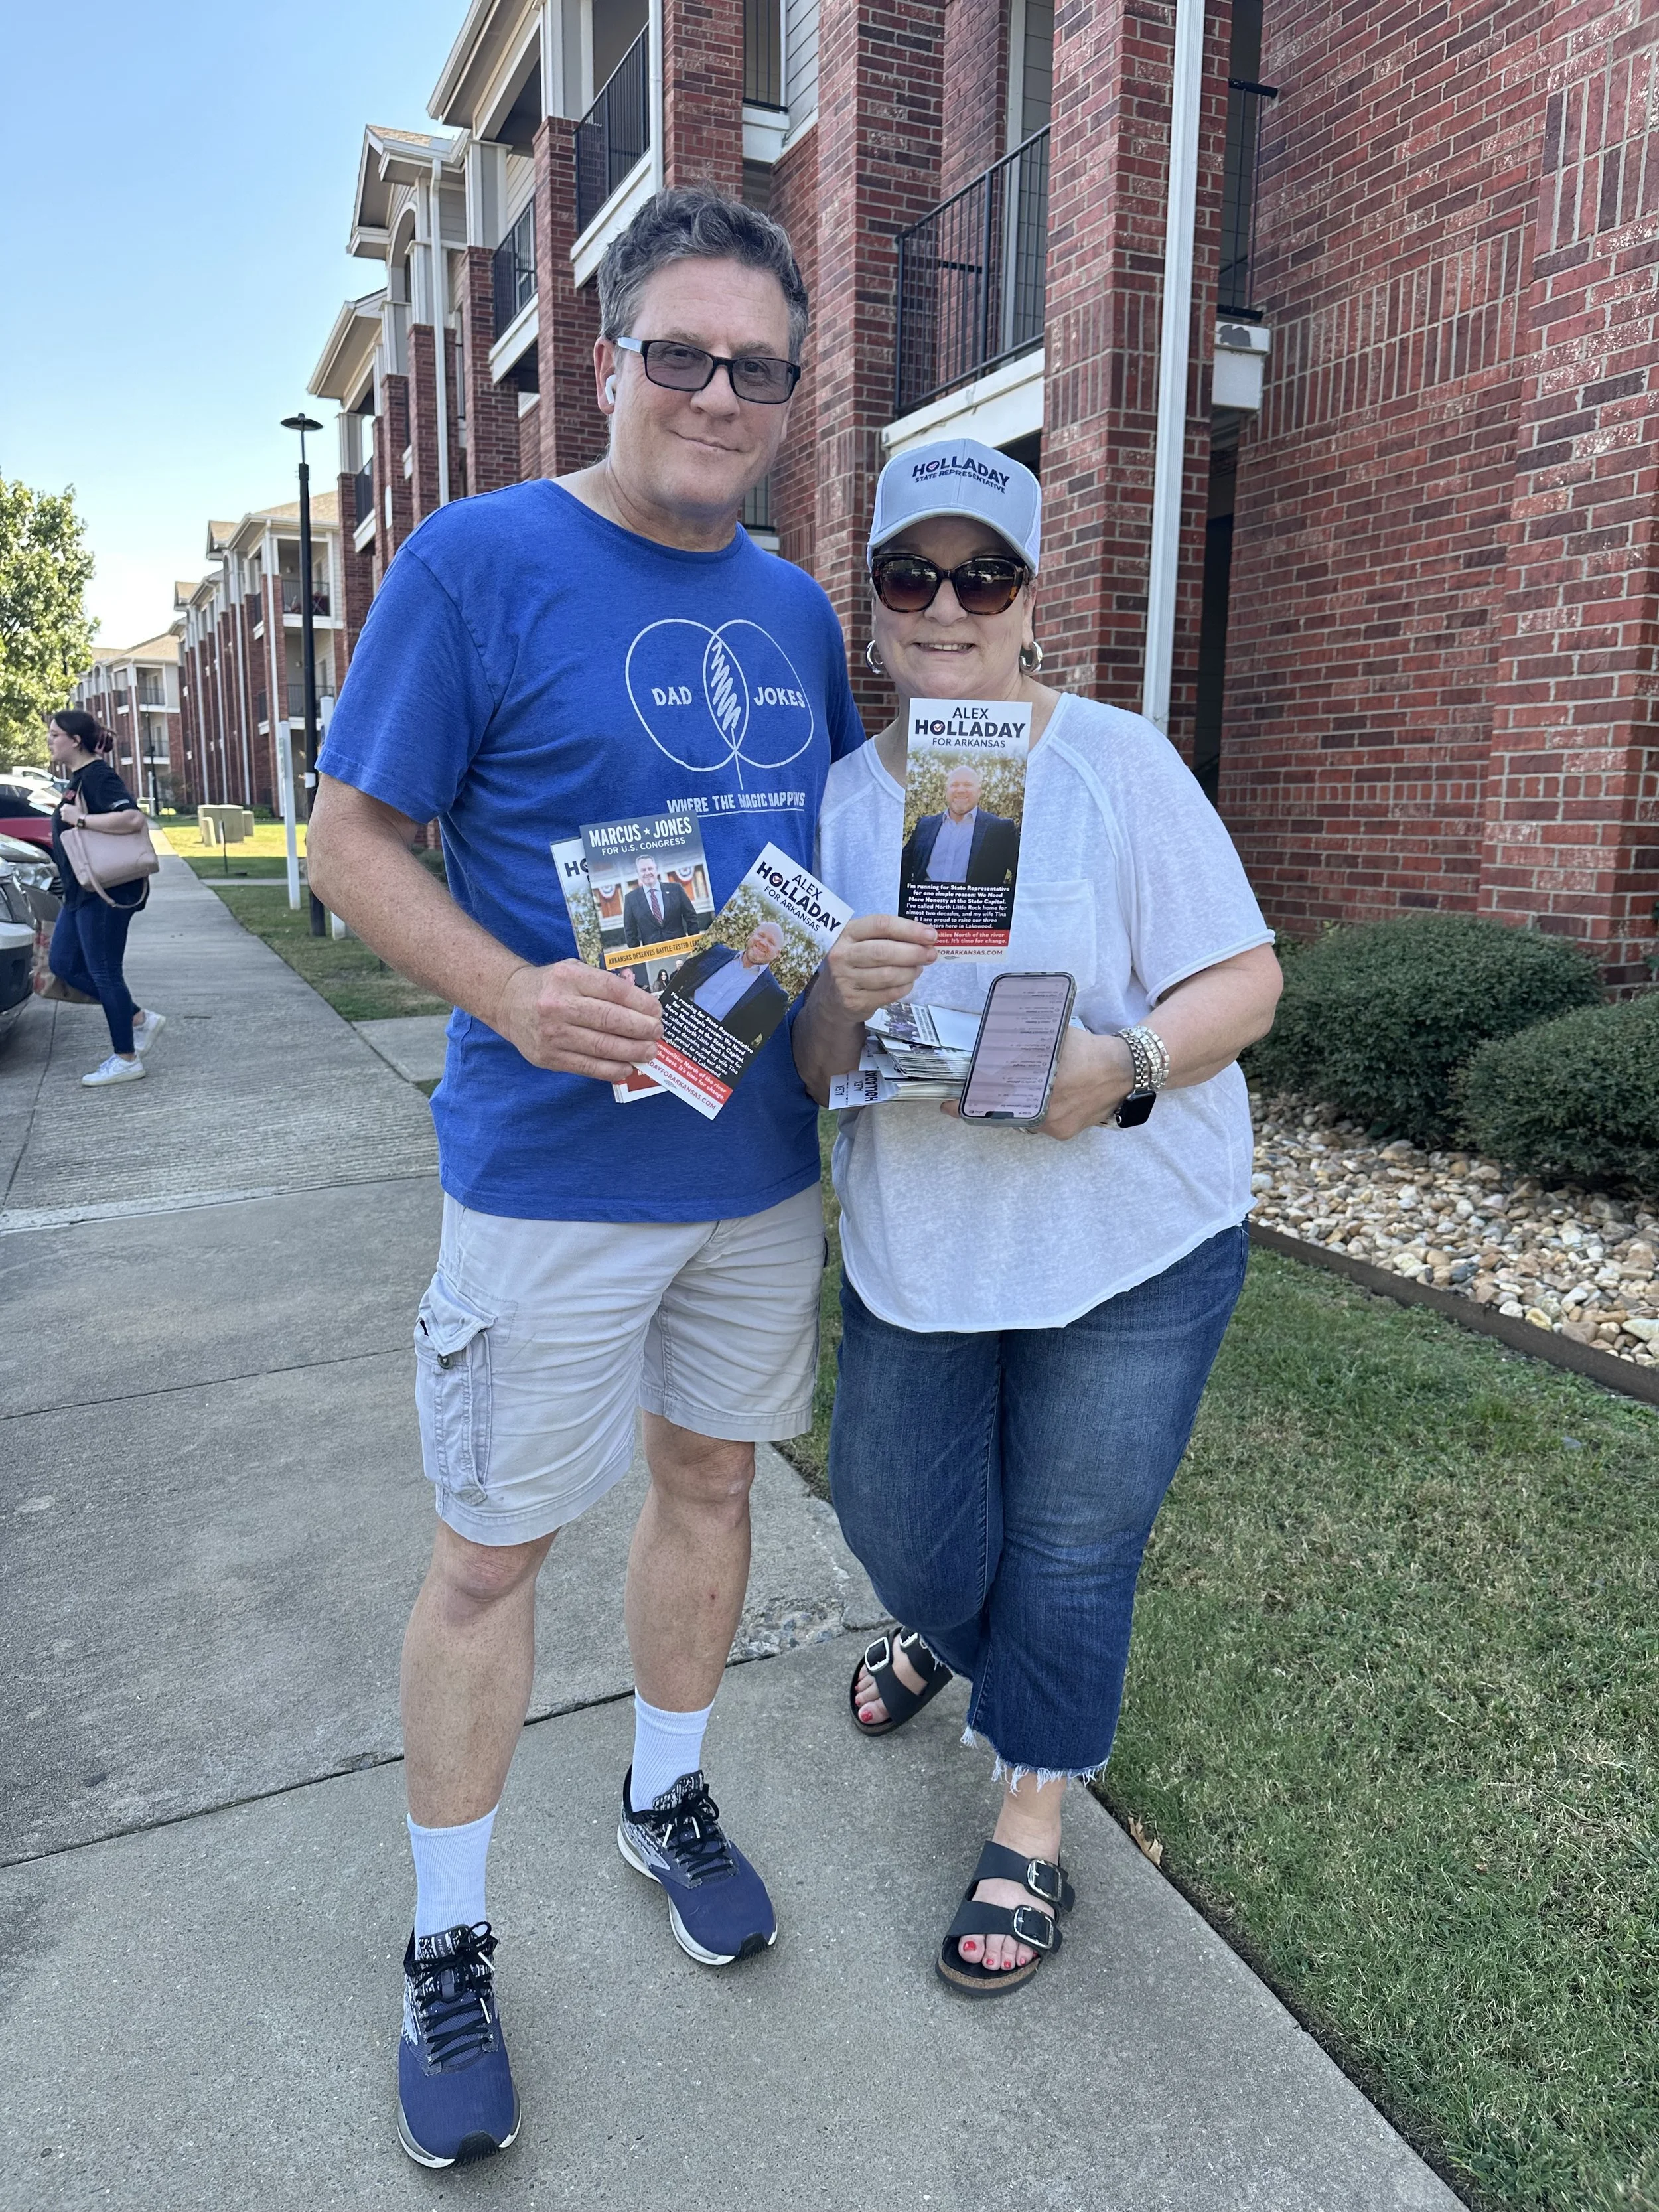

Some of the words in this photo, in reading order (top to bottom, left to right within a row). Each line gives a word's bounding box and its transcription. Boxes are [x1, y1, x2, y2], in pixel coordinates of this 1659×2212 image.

[912, 456, 1010, 487] HOLLADAY
[915, 472, 938, 482] STATE
[939, 469, 1005, 494] REPRESENTATIVE
[651, 686, 692, 705] DAD
[754, 687, 805, 708] JOKES
[915, 719, 1026, 738] HOLLADAY
[952, 707, 989, 719] ALEX
[954, 739, 1005, 747] ARKANSAS
[667, 797, 709, 813] WHERE
[712, 794, 735, 810] THE
[738, 793, 768, 808] MAGIC
[589, 824, 642, 847] MARCUS
[653, 817, 692, 838] JONES
[601, 847, 618, 855] FOR
[640, 837, 685, 850] CONGRESS
[757, 861, 841, 932] HOLLADAY
[792, 875, 822, 900] ALEX
[764, 886, 780, 901] FOR
[780, 899, 820, 932] ARKANSAS
[609, 954, 632, 964] ARKANSAS
[633, 950, 655, 959] DESERVES
[656, 942, 689, 954] BATTLE-TESTED
[665, 1004, 678, 1015] More
[679, 1014, 698, 1030] Honesty
[713, 1038, 725, 1049] State
[669, 1015, 684, 1027] called
[683, 1025, 697, 1037] North
[697, 1035, 709, 1046] Little
[709, 1043, 721, 1055] Rock
[721, 1052, 734, 1064] home
[679, 997, 697, 1014] running
[705, 1017, 719, 1028] State
[719, 1026, 753, 1054] Representative
[690, 1015, 705, 1027] simple
[706, 1026, 724, 1040] reason:
[732, 1043, 746, 1055] Need
[660, 1018, 672, 1027] most
[672, 1025, 681, 1034] two
[682, 1032, 700, 1049] decades,
[701, 1046, 711, 1055] and
[719, 1059, 728, 1067] wife
[729, 1065, 738, 1074] Tina
[661, 1035, 681, 1050] aughters
[682, 1047, 692, 1058] here
[698, 1059, 721, 1078] Lakewood.
[674, 1036, 690, 1048] proud
[695, 1050, 707, 1060] raise
[715, 1064, 727, 1075] three
[656, 1042, 684, 1063] ommunities
[684, 1061, 699, 1074] North
[714, 1083, 727, 1093] river
[666, 1056, 678, 1067] best.
[687, 1072, 698, 1082] time
[707, 1084, 725, 1101] change.
[649, 1061, 716, 1110] DAYFORARKANSAS.COM
[835, 1085, 844, 1095] ALEX
[854, 1080, 863, 1091] ALEX
